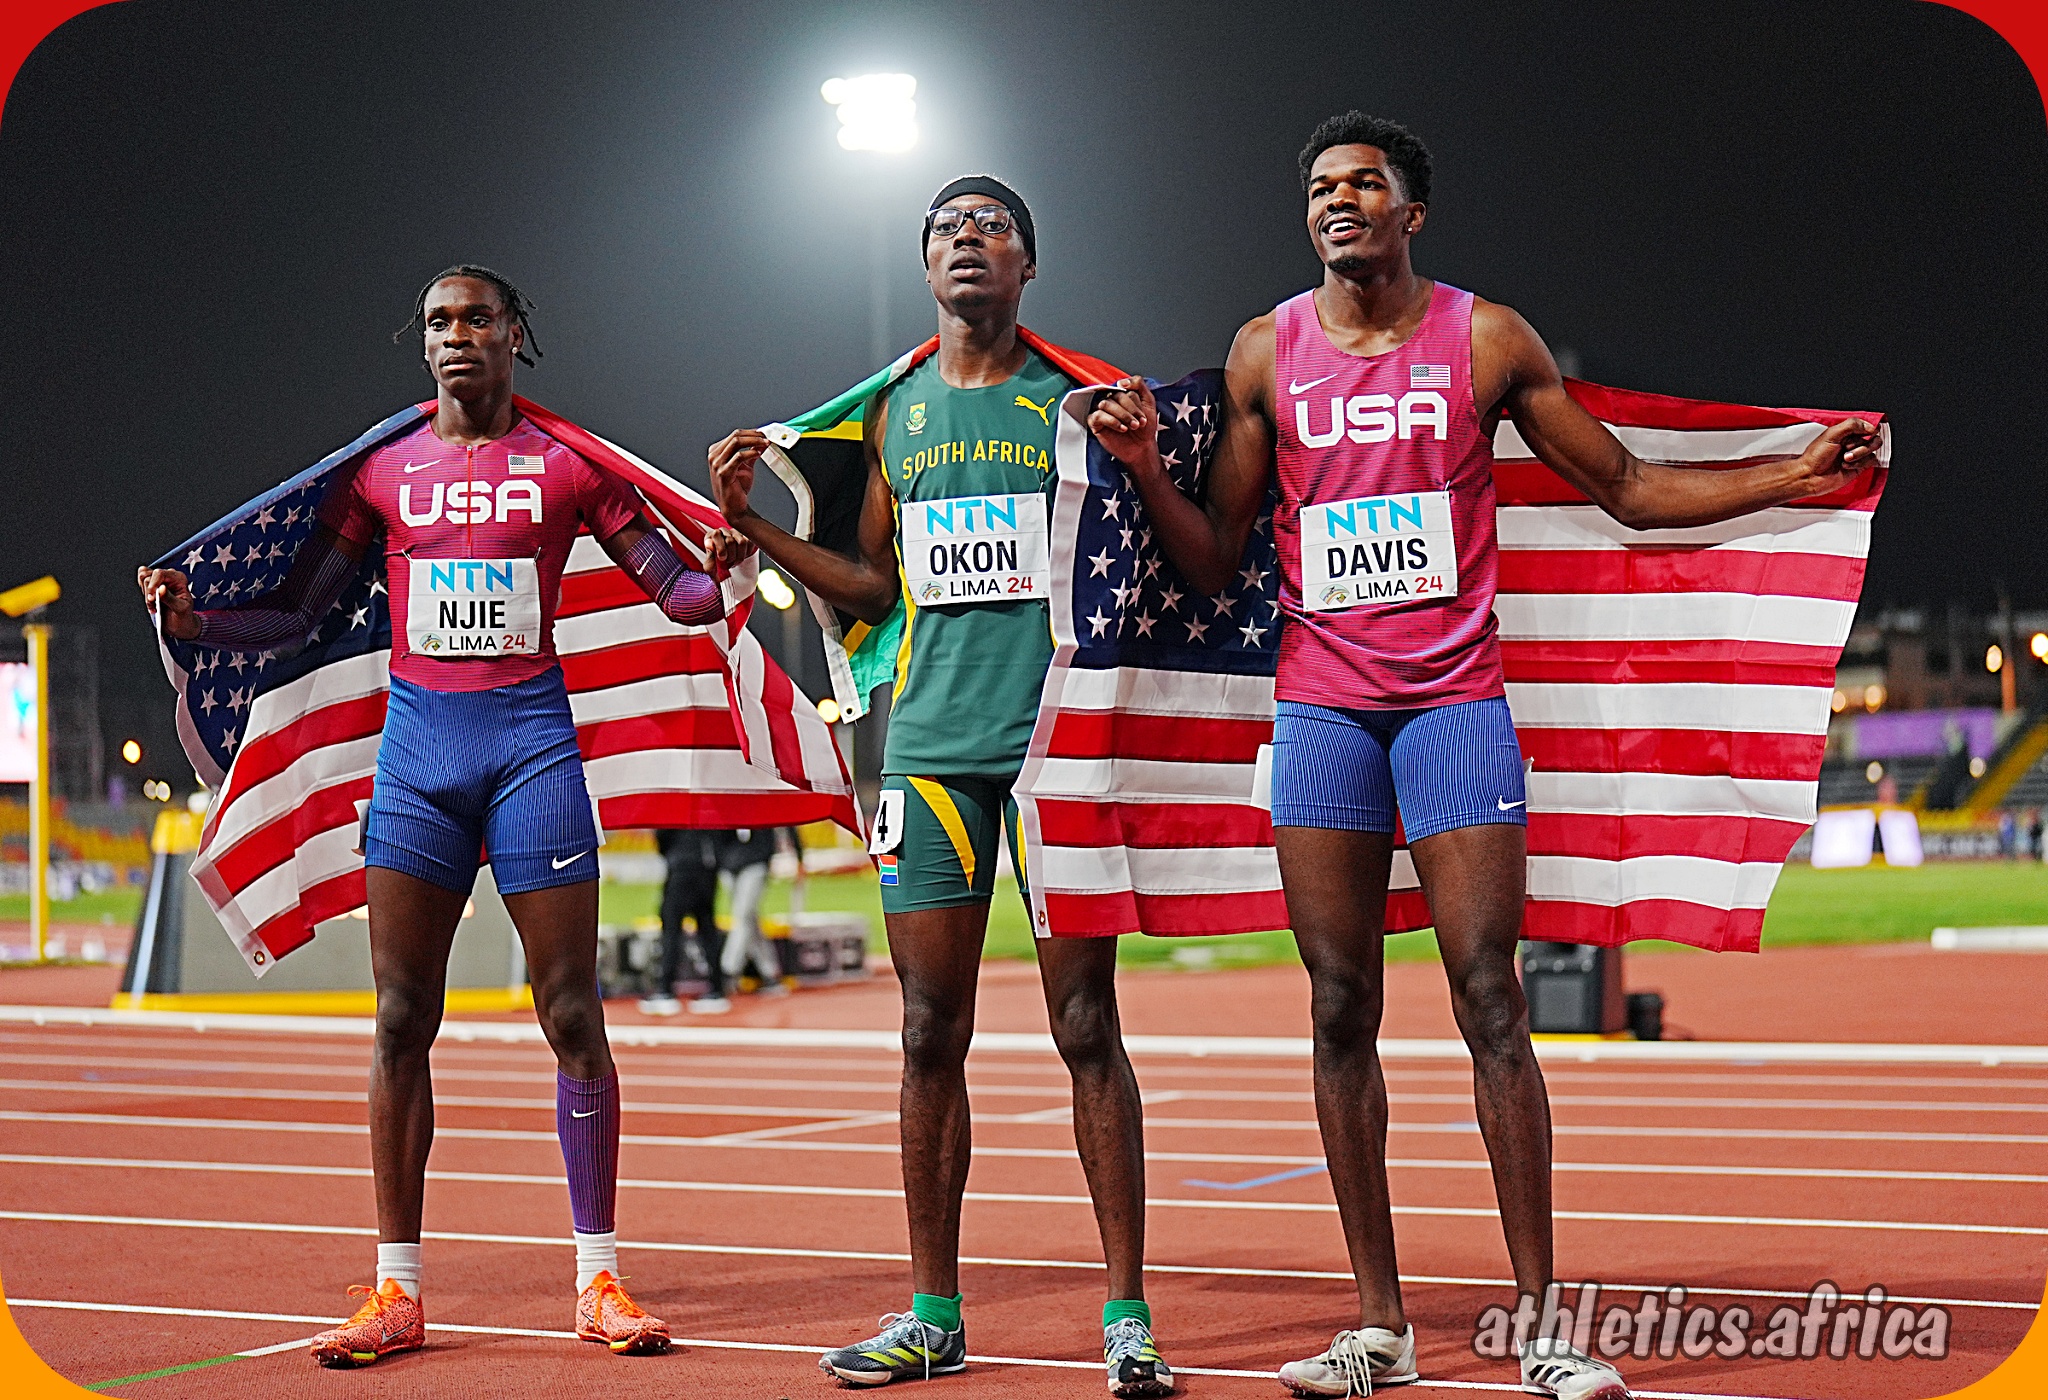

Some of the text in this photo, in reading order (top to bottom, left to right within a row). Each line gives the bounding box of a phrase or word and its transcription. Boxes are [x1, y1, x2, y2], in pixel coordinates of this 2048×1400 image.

[1295, 391, 1448, 449] USA
[902, 439, 1049, 480] SOUTH AFRICA
[399, 479, 543, 527] USA
[926, 497, 1017, 536] NTN
[1325, 496, 1423, 539] NTN
[430, 561, 514, 593] NTN
[929, 539, 1018, 576] OKON
[1327, 538, 1428, 579] DAVIS
[950, 576, 1034, 597] LIMA 24
[1355, 575, 1443, 600] LIMA 24
[439, 600, 506, 629] NJIE
[449, 634, 526, 650] LIMA 24
[877, 800, 889, 844] 4
